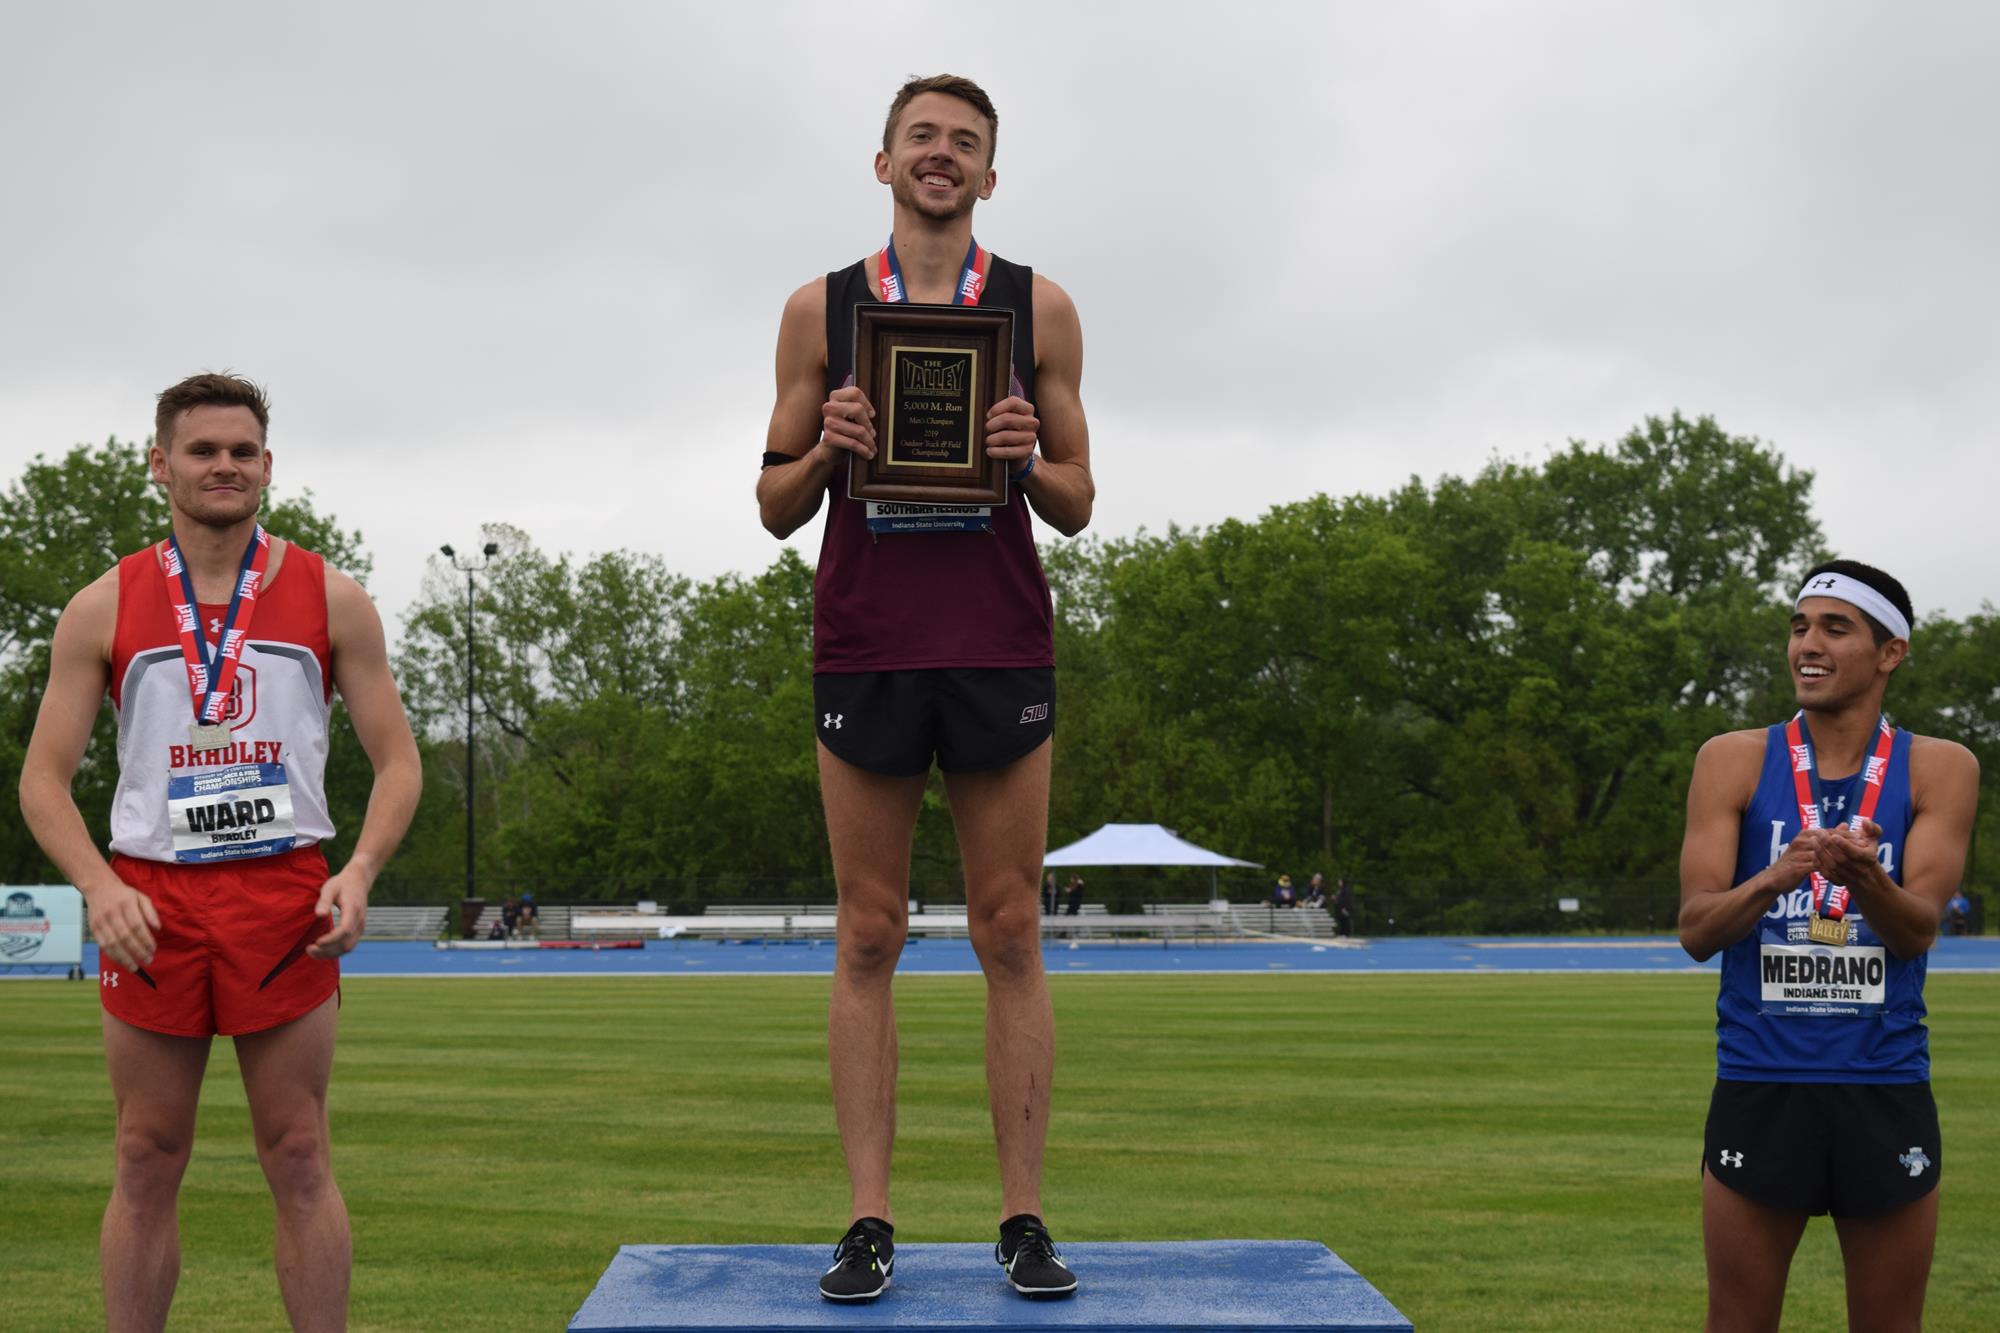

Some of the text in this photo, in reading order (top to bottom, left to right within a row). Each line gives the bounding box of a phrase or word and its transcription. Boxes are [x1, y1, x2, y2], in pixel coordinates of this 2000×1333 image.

[961, 268, 982, 300] VALLEY
[902, 357, 966, 391] VALLEY
[924, 360, 943, 368] THE
[904, 401, 963, 412] 5,000 M. Run
[927, 417, 955, 426] Champion
[924, 430, 939, 438] 2019
[948, 440, 962, 449] Field
[877, 504, 935, 515] SOUTHERN
[163, 547, 184, 578] VALLEY
[239, 569, 262, 600] VALLEY
[174, 603, 196, 632] VALLEY
[221, 629, 245, 660] VALLEY
[188, 663, 209, 695] VALLEY
[204, 691, 228, 723] VALLEY
[1020, 703, 1048, 724] SIU
[169, 741, 282, 768] BRADLEY
[1791, 744, 1812, 772] VALLEY
[194, 777, 221, 786] OUTDOOR
[1864, 756, 1886, 786] VALLEY
[193, 775, 262, 793] CHAMPIONSHIPS
[186, 798, 275, 832] WARD
[1800, 804, 1821, 830] ALLEY
[211, 828, 257, 843] BRADLEY
[201, 851, 224, 859] Indiana
[241, 845, 272, 855] University
[1811, 918, 1848, 941] VALLEY
[1763, 955, 1884, 986] MEDRANO
[1784, 988, 1862, 1000] INDIANA STATE
[1826, 1006, 1860, 1015] University
